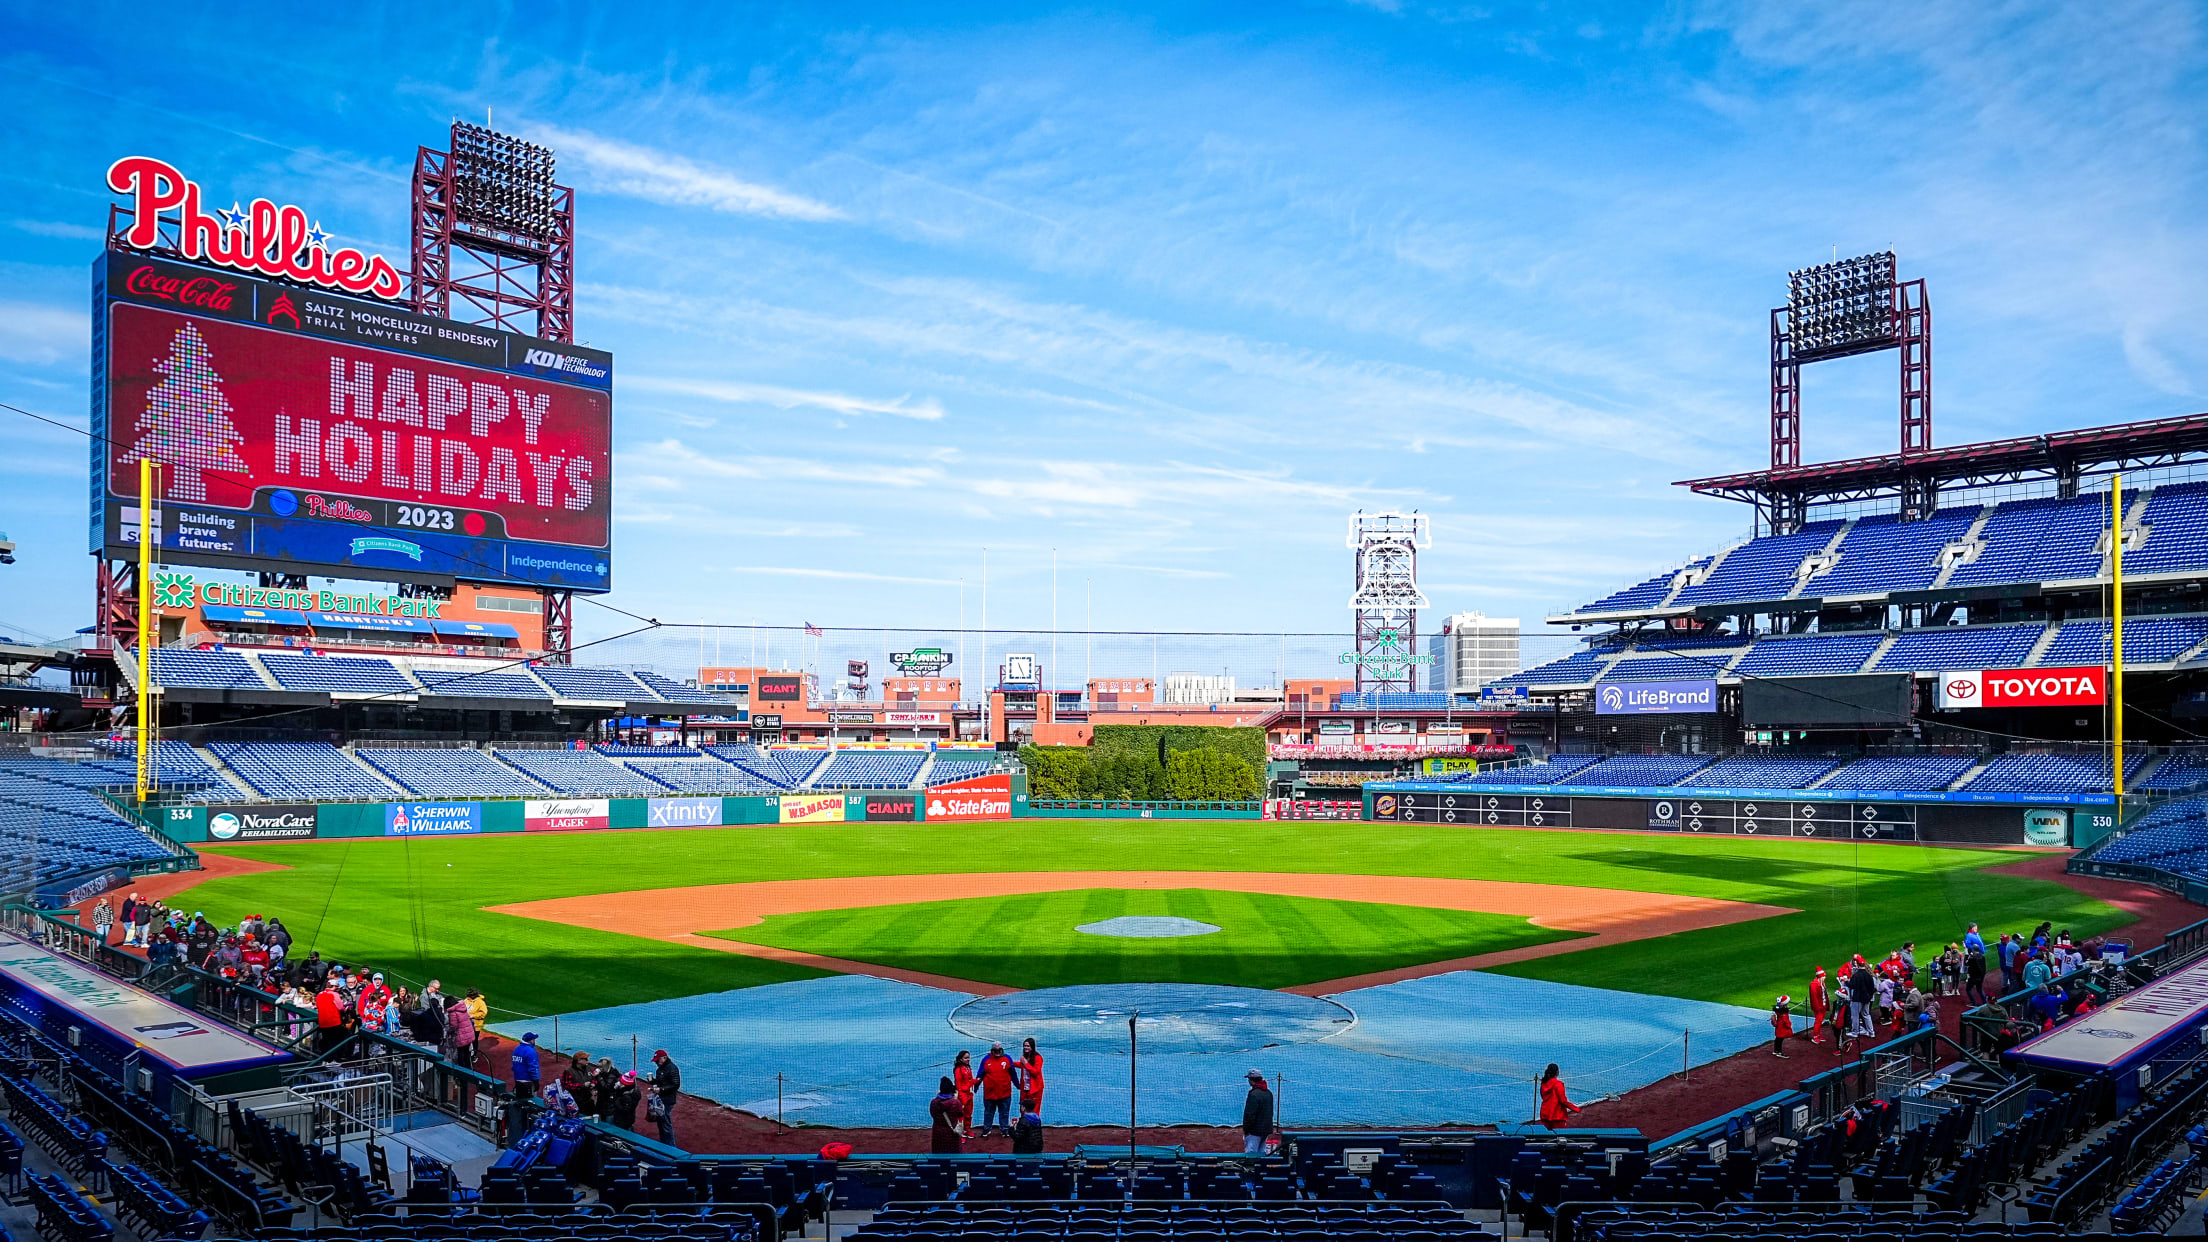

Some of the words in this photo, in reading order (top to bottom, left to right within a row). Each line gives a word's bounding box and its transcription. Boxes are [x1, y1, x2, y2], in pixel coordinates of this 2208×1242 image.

[106, 155, 402, 299] Phillies
[126, 266, 239, 312] Coca-Cola
[305, 302, 345, 318] SALTZ
[351, 311, 432, 335] MONGELUZZI
[438, 328, 499, 348] BENDESKY
[306, 315, 346, 331] TRIAL
[357, 326, 418, 345] LAWYERS
[524, 348, 565, 370] KDI
[565, 356, 588, 367] OFFICE
[562, 363, 606, 378] TECHNOLOGY
[330, 356, 551, 445] HAPPY
[275, 413, 593, 511] HOLIDAYS
[305, 494, 372, 522] Phillies
[397, 506, 454, 530] 2023
[179, 512, 235, 530] Building
[179, 524, 217, 538] brave
[511, 555, 593, 573] Independence
[202, 582, 313, 611] Citizens
[318, 589, 383, 615] Bank
[387, 594, 441, 618] Park
[322, 614, 371, 624] HARRY
[1341, 652, 1397, 664] Citizens
[1400, 652, 1436, 664] Bank
[1373, 667, 1402, 679] Park
[762, 685, 796, 693] GIANT
[1989, 677, 2097, 697] TOYOTA
[1629, 688, 1709, 705] LifeBrand
[766, 798, 778, 806] 374
[867, 803, 914, 814] GIANT
[170, 809, 193, 820] 334
[412, 806, 470, 819] SHERWIN
[541, 804, 595, 817] Yuengling
[653, 801, 718, 824] xfinity
[241, 813, 315, 828] NovaCare
[551, 818, 584, 828] LAGER
[2092, 816, 2112, 827] 330
[241, 829, 311, 837] REHABILITATION
